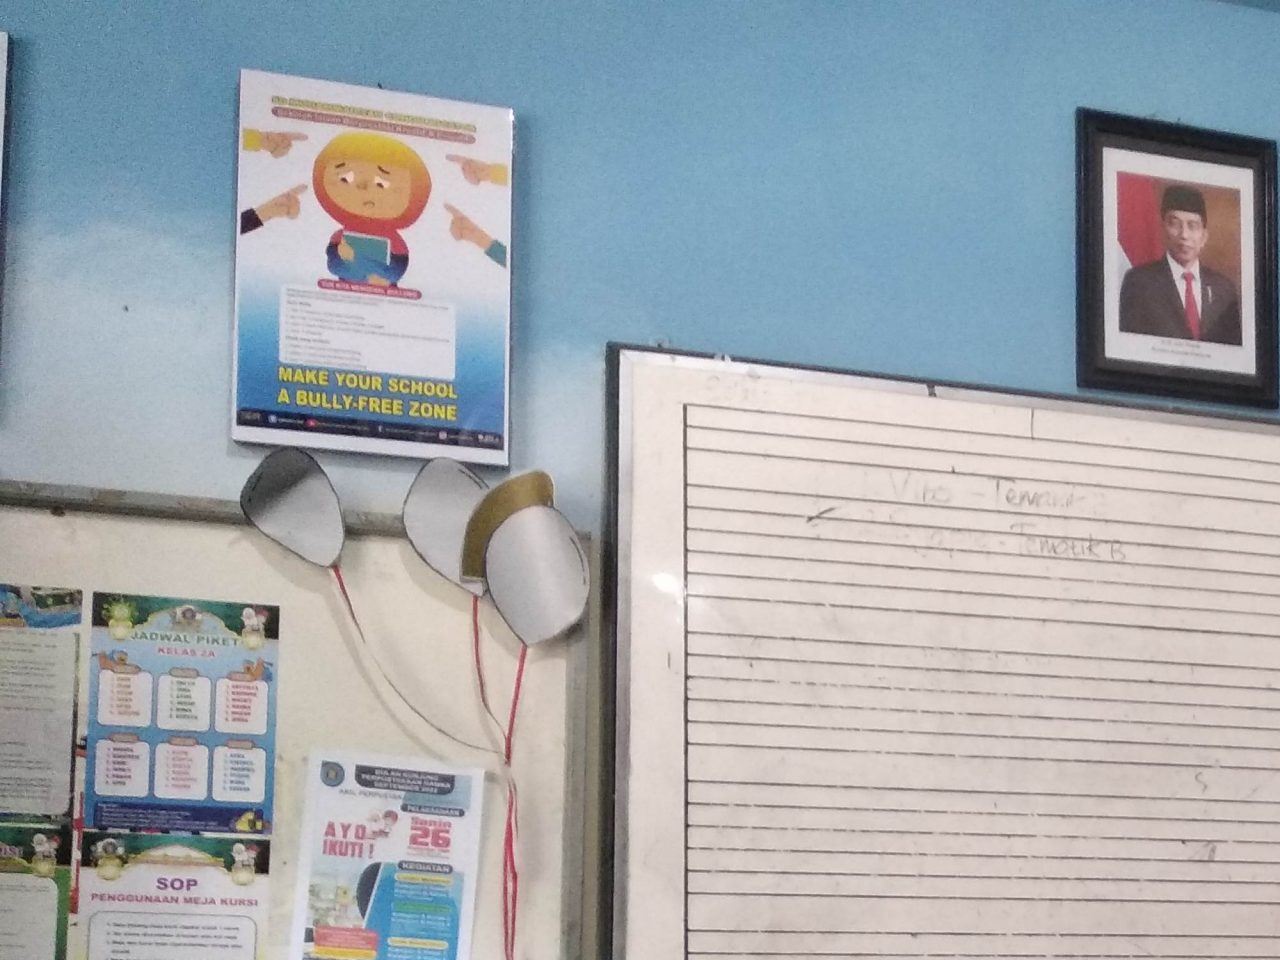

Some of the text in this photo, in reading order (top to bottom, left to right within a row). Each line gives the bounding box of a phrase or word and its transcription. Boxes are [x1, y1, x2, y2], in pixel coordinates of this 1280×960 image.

[278, 366, 457, 399] MAKE YOUR SCHOOL
[277, 390, 457, 421] A BULLY-FREE ZONE
[196, 635, 238, 647] PIKET
[158, 647, 197, 656] KELAS
[324, 821, 366, 840] AYO
[409, 826, 451, 848] 26
[322, 841, 364, 859] IKUTI
[402, 862, 450, 873] KEGIATAN
[156, 877, 198, 891] SOP
[90, 893, 259, 907] PENGGUNAAN MEJA KURSI
